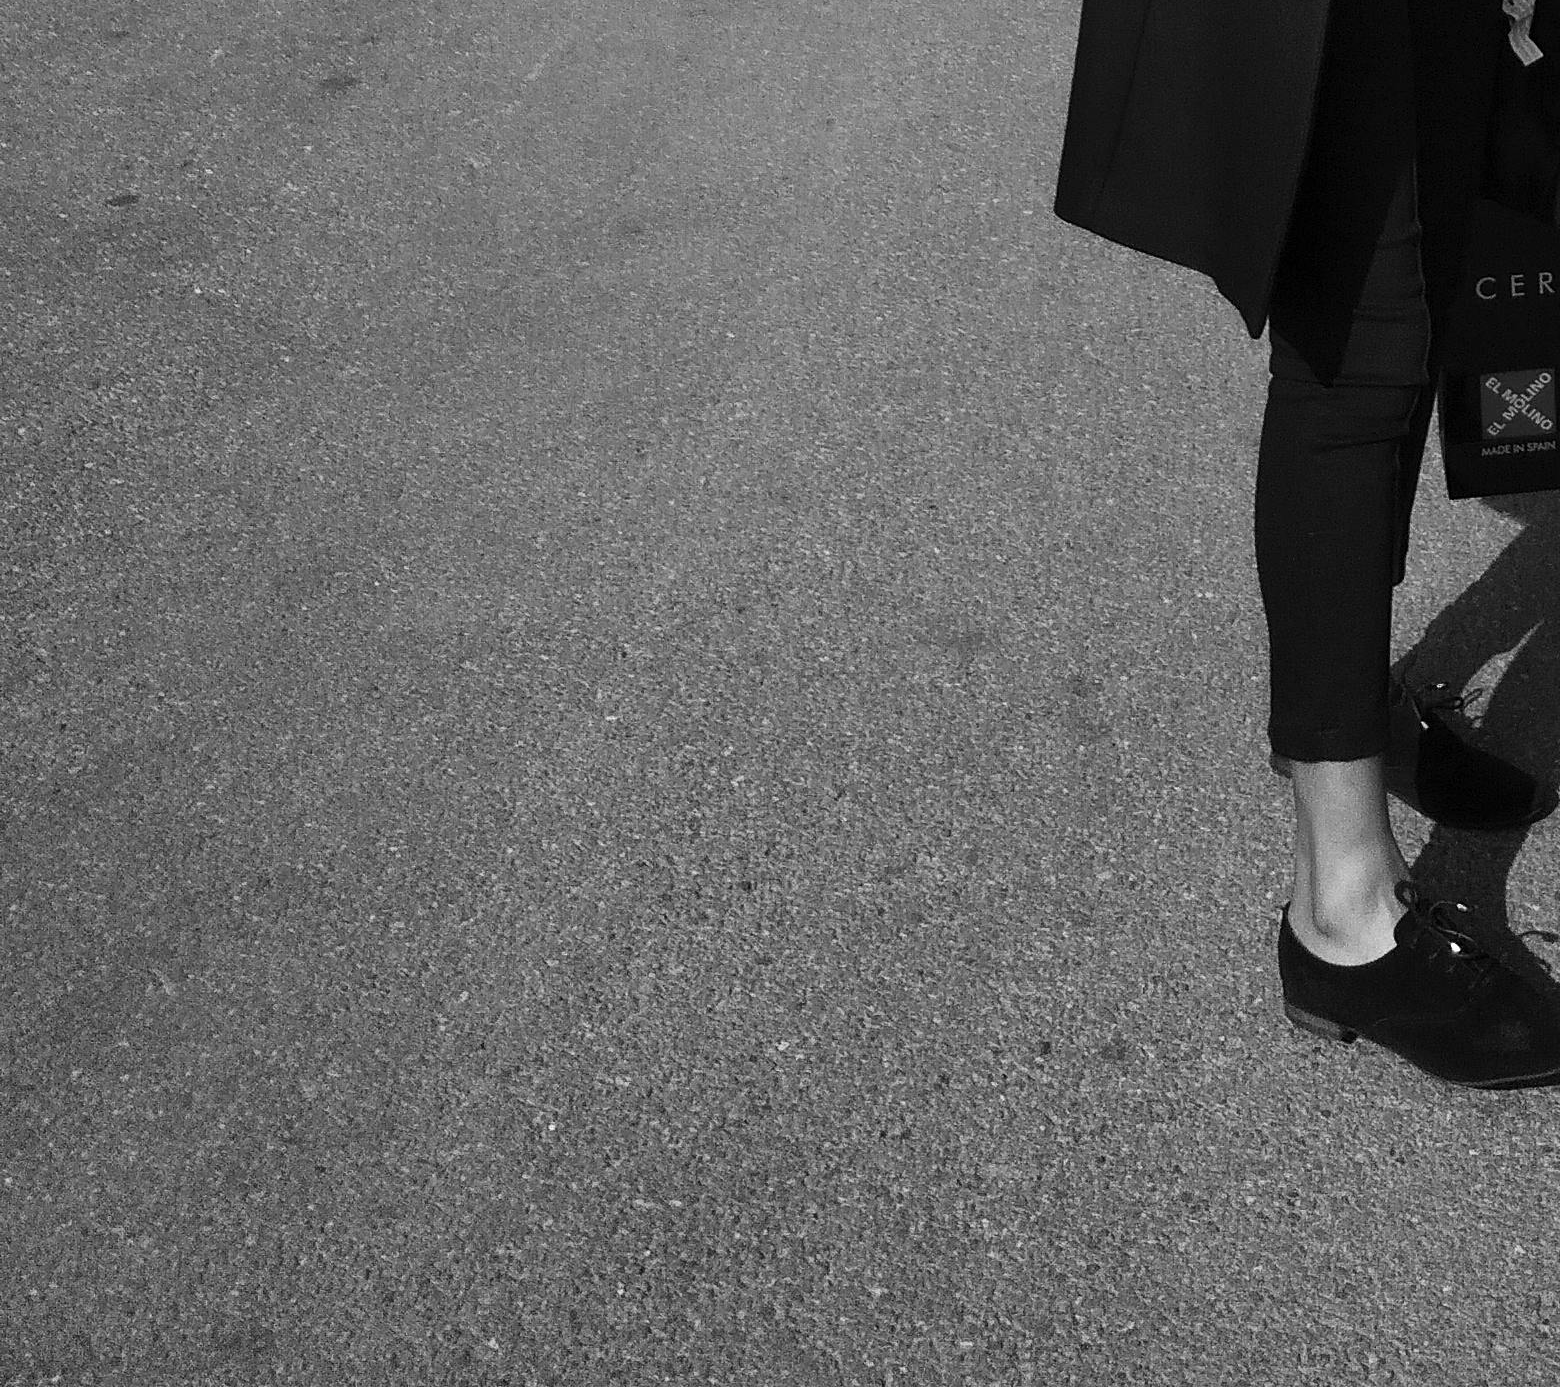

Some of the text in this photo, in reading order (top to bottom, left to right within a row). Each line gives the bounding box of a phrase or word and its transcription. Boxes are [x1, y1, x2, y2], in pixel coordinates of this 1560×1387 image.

[1485, 377, 1553, 430] EL MOLINO
[1486, 372, 1552, 436] EL MOLINO
